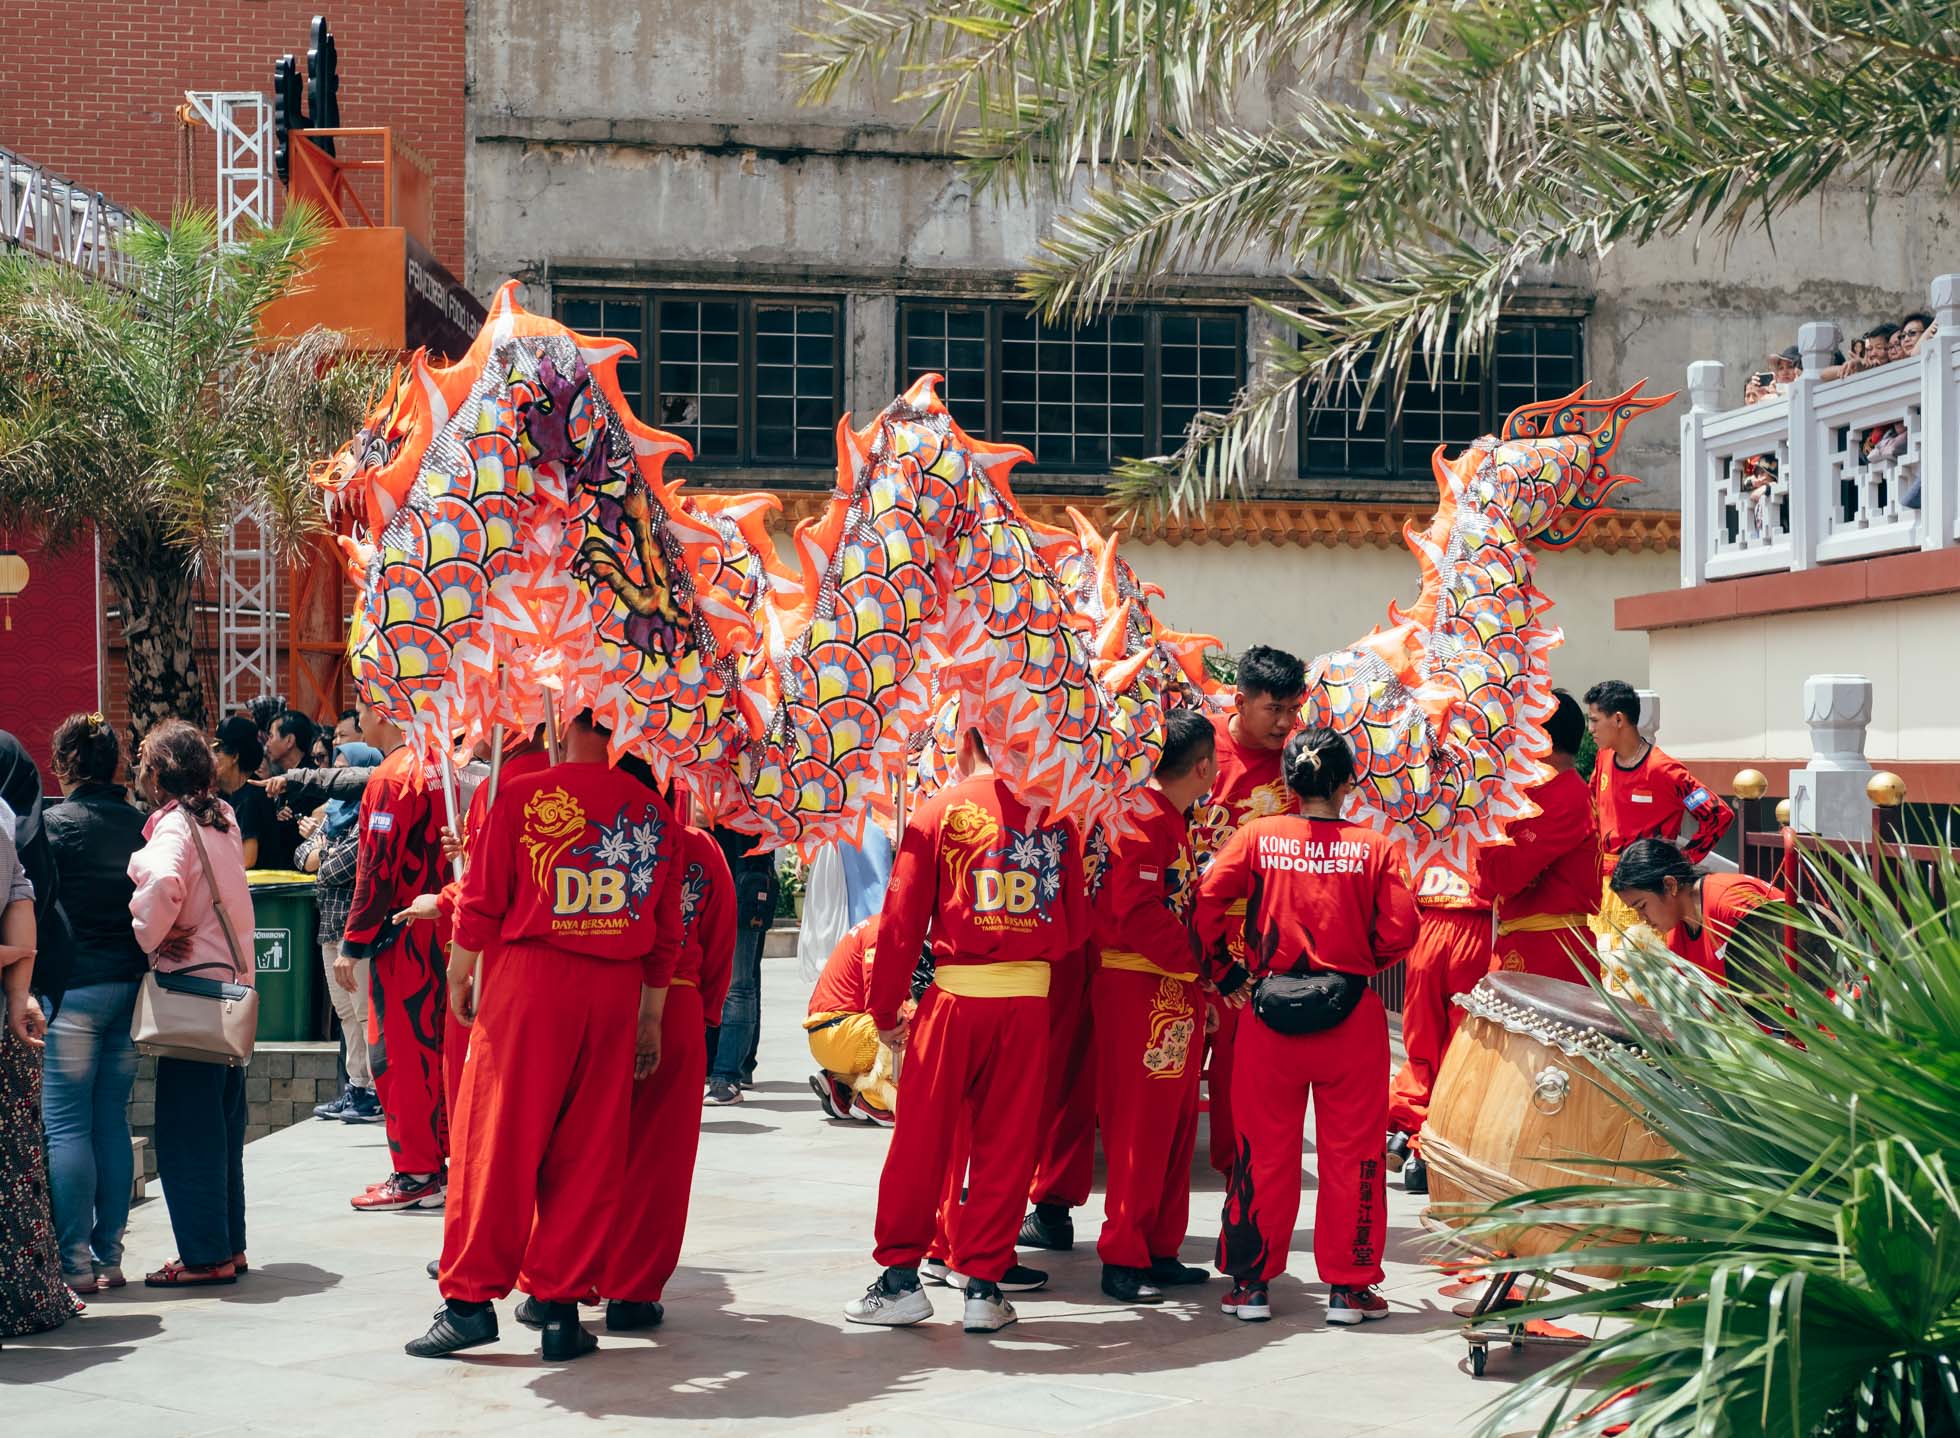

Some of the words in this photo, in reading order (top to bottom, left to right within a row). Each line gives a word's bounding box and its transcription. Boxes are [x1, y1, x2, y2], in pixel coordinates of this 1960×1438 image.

[1259, 835, 1300, 856] KONG
[1305, 841, 1325, 859] HA
[1329, 841, 1370, 860] HONG
[1260, 855, 1364, 875] INDONESIA
[553, 867, 626, 914] DB
[971, 869, 1037, 913] DB
[1417, 896, 1434, 905] AYA
[552, 919, 578, 930] DAYA
[581, 918, 629, 930] BERSAMA
[974, 916, 1002, 926] DAYA
